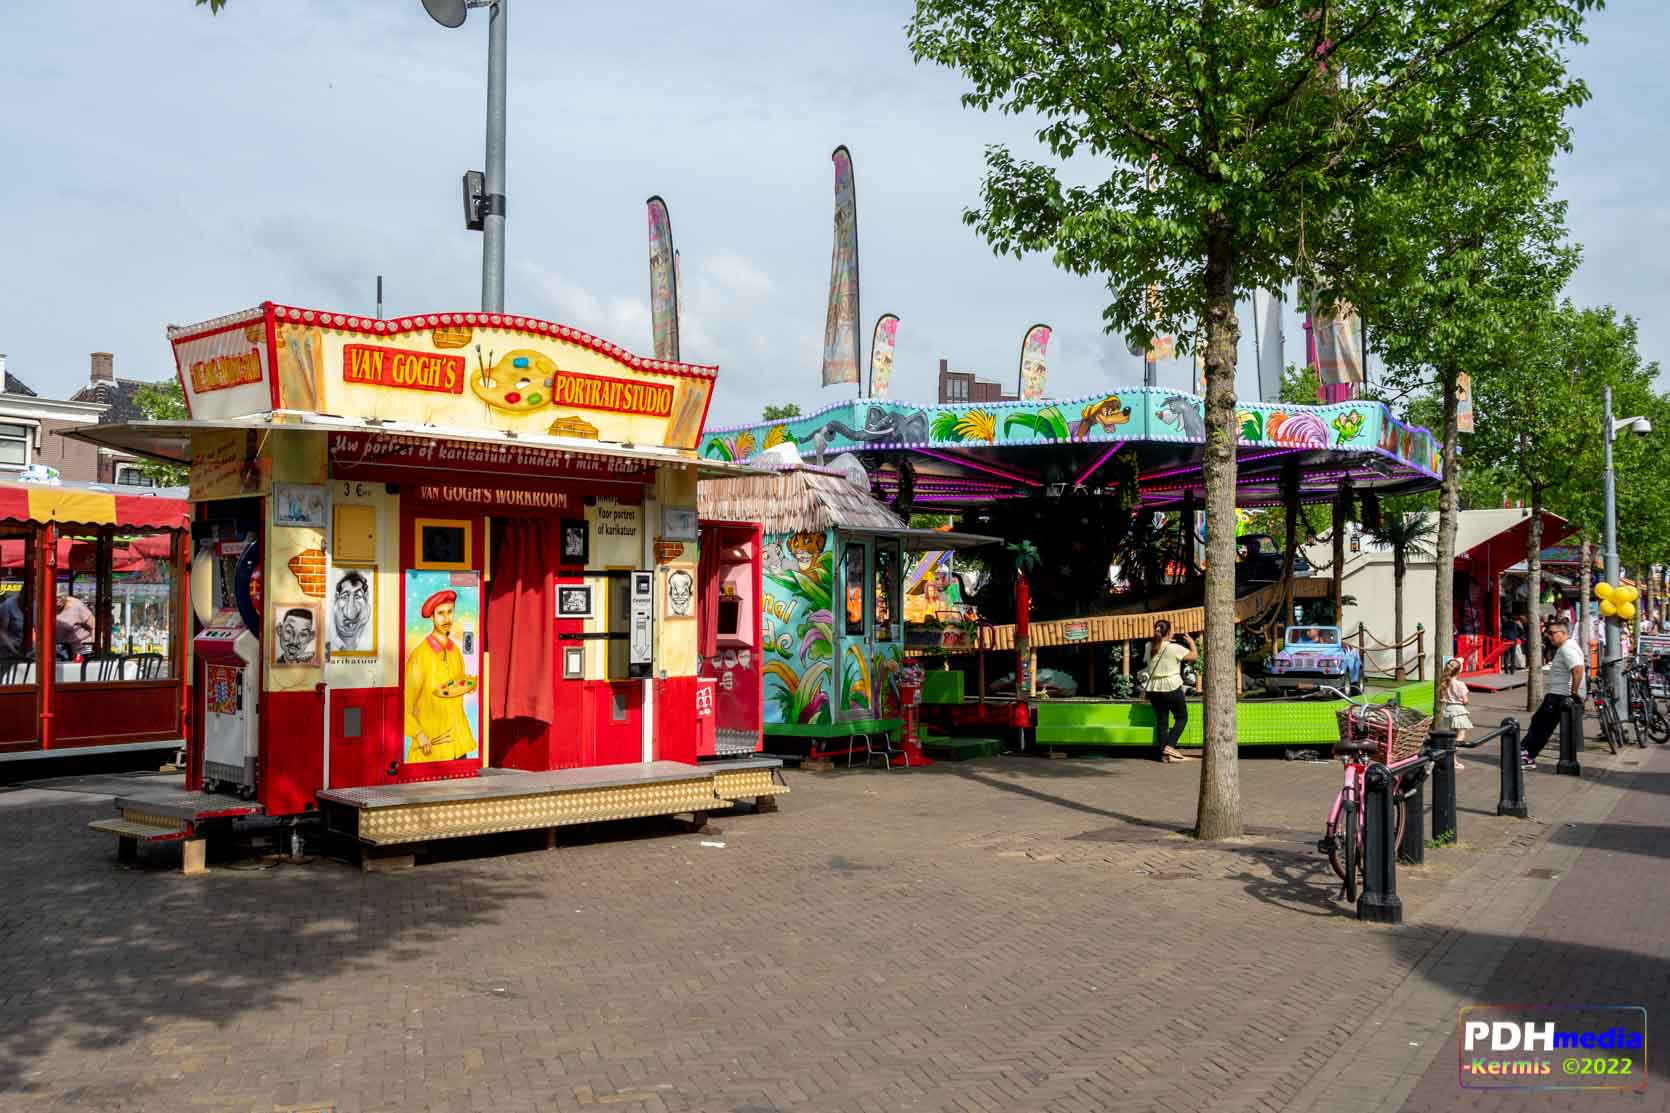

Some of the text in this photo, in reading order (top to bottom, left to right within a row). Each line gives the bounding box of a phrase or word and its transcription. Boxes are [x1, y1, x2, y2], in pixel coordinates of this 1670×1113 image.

[351, 348, 457, 389] VAN GOGH'S
[555, 375, 671, 414] PORTRAIT STUDIO
[418, 445, 435, 461] of
[438, 445, 512, 464] karikatuur
[517, 452, 560, 467] binnen
[343, 482, 351, 497] 3
[421, 485, 568, 509] VAN GOGH'S WORKROOM
[613, 510, 636, 521] portret
[598, 524, 637, 537] of karikatuur
